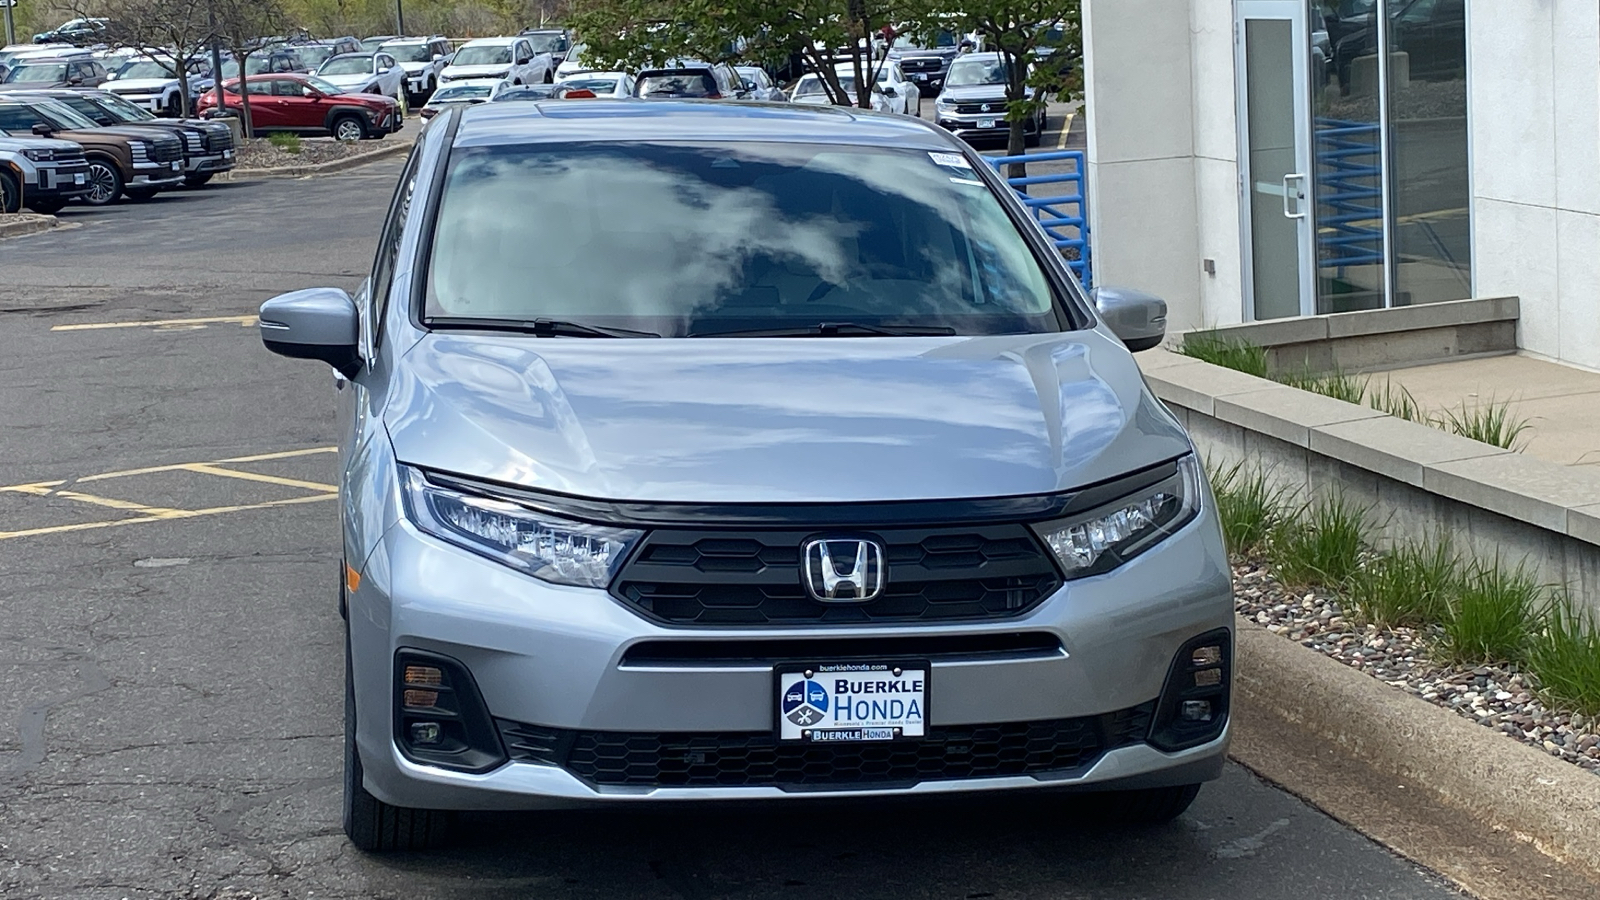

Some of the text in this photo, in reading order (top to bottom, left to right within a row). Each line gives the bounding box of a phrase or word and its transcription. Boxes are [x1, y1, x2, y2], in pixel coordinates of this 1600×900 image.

[819, 664, 888, 672] buerklehonda.com
[834, 679, 923, 695] BUERKLE
[834, 695, 922, 721] HONDA
[813, 729, 892, 740] BUERKLE HONDA
